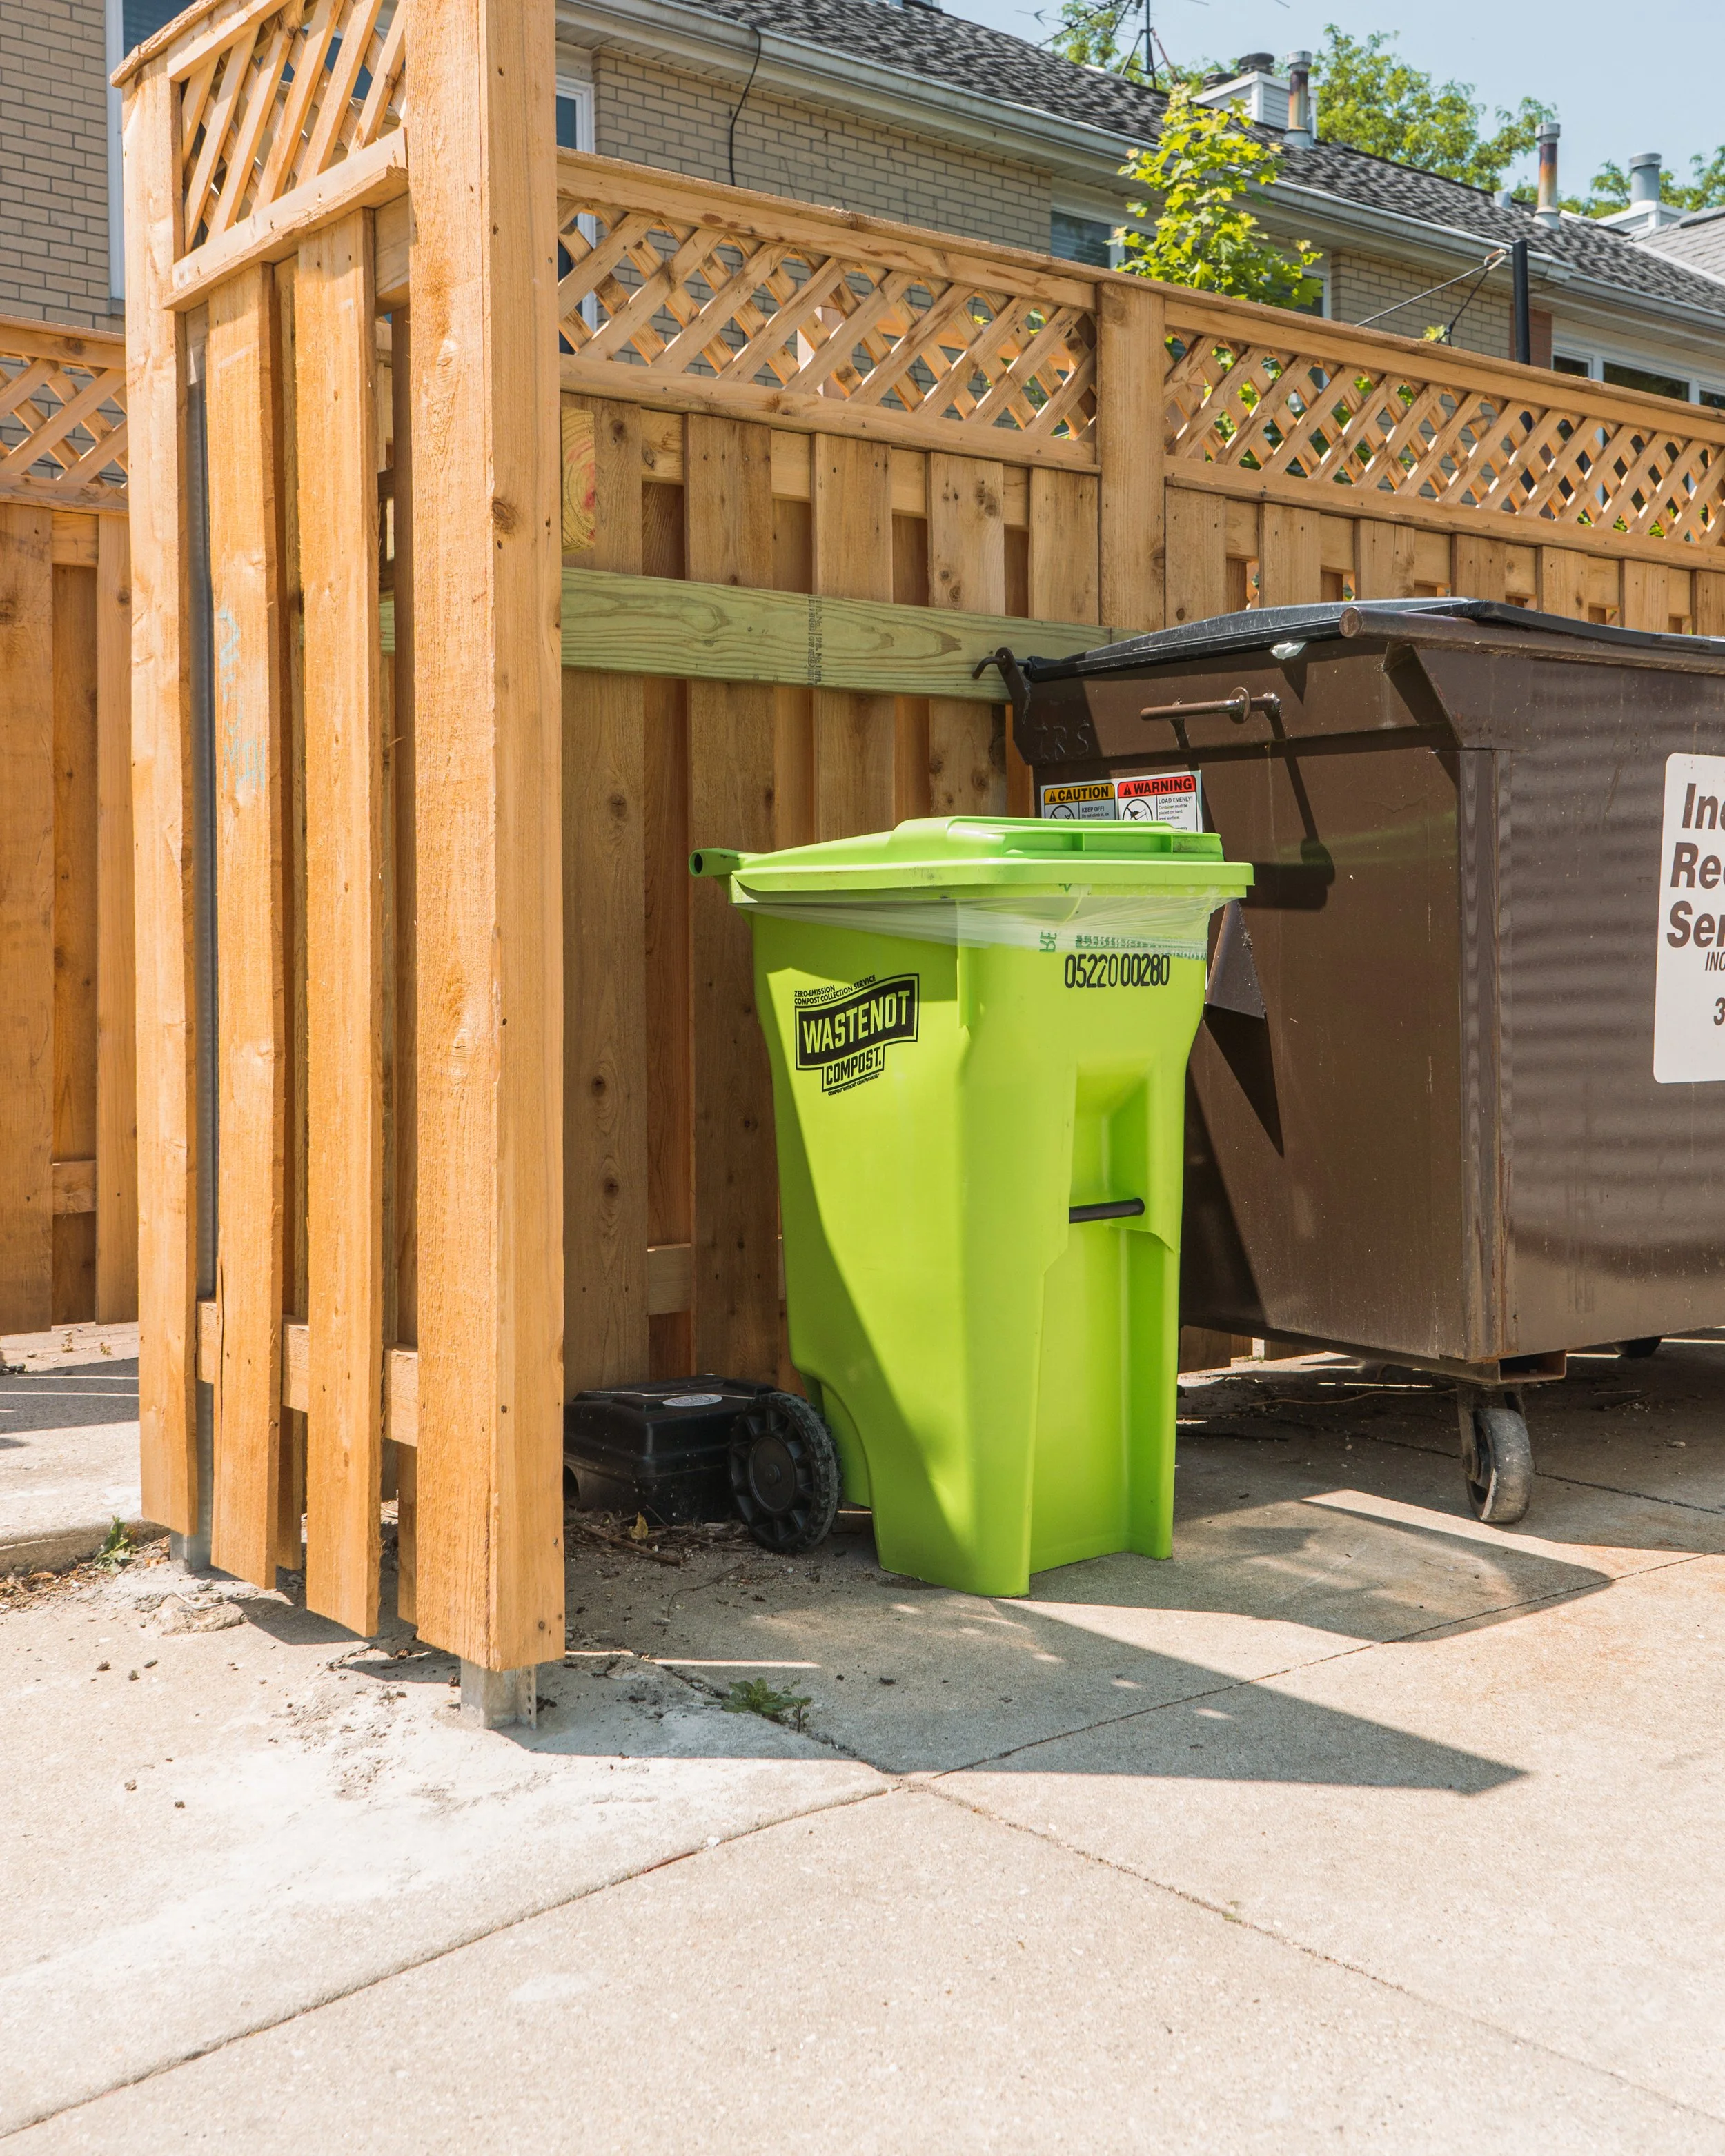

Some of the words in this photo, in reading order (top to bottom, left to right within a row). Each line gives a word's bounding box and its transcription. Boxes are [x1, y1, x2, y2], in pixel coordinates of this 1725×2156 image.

[1058, 786, 1110, 802] CAUTION
[1134, 778, 1192, 793] WARNING
[1682, 783, 1725, 831] In
[1670, 842, 1725, 889] Re
[794, 996, 820, 1005] COMPOST
[820, 985, 853, 1002] COLLECTION
[854, 975, 876, 989] SERVICE
[794, 985, 835, 997] ZERO-EMISSION
[802, 990, 910, 1054] WASTENOT
[826, 1046, 882, 1085] COMPOST.
